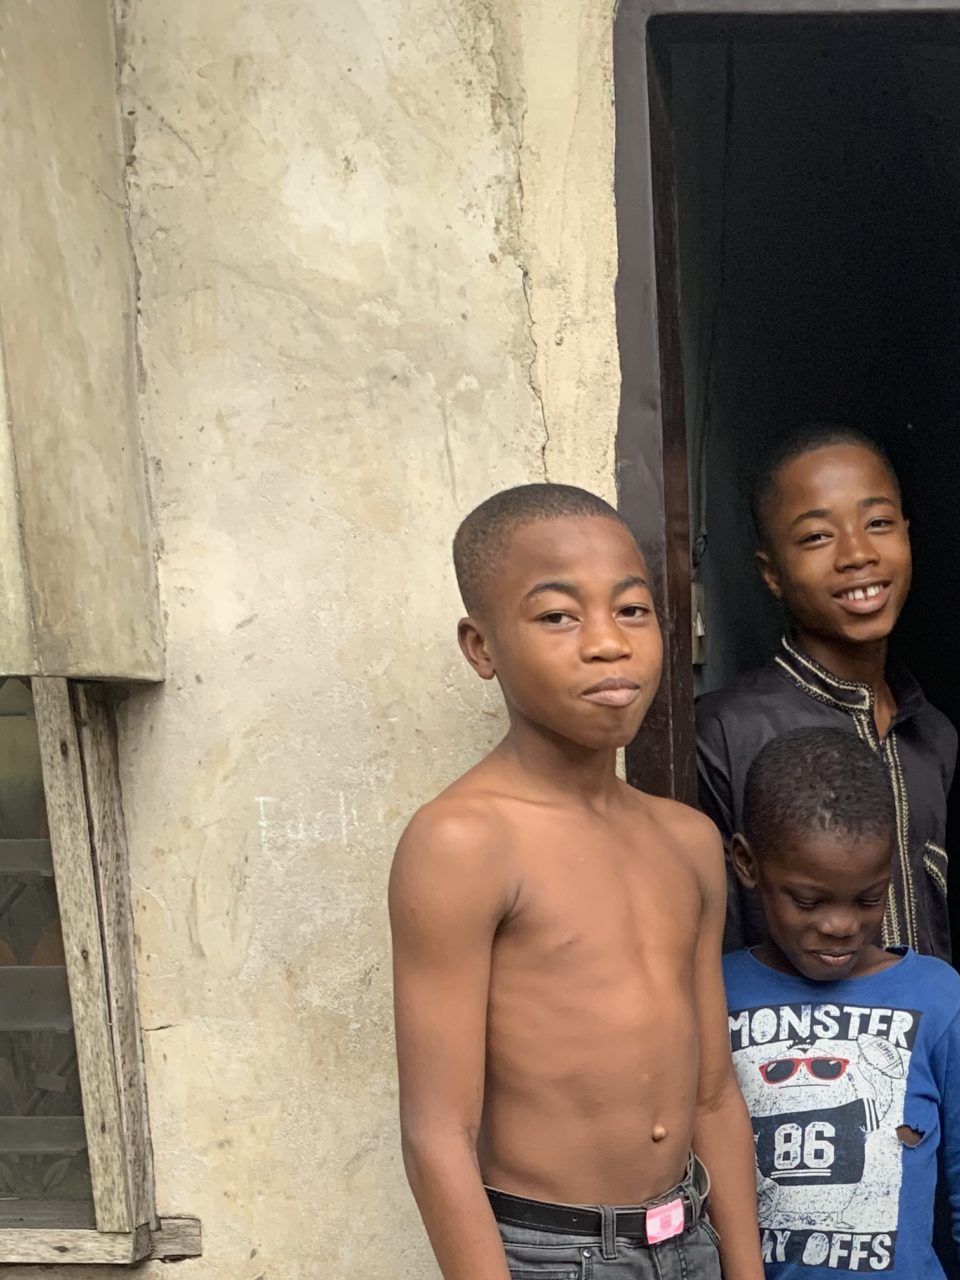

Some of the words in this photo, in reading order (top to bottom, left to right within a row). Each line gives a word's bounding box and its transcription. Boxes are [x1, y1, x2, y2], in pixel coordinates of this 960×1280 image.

[727, 1004, 914, 1049] MONSTER
[774, 1121, 836, 1170] 86
[761, 1229, 791, 1264] AY
[802, 1232, 892, 1271] OFFS
